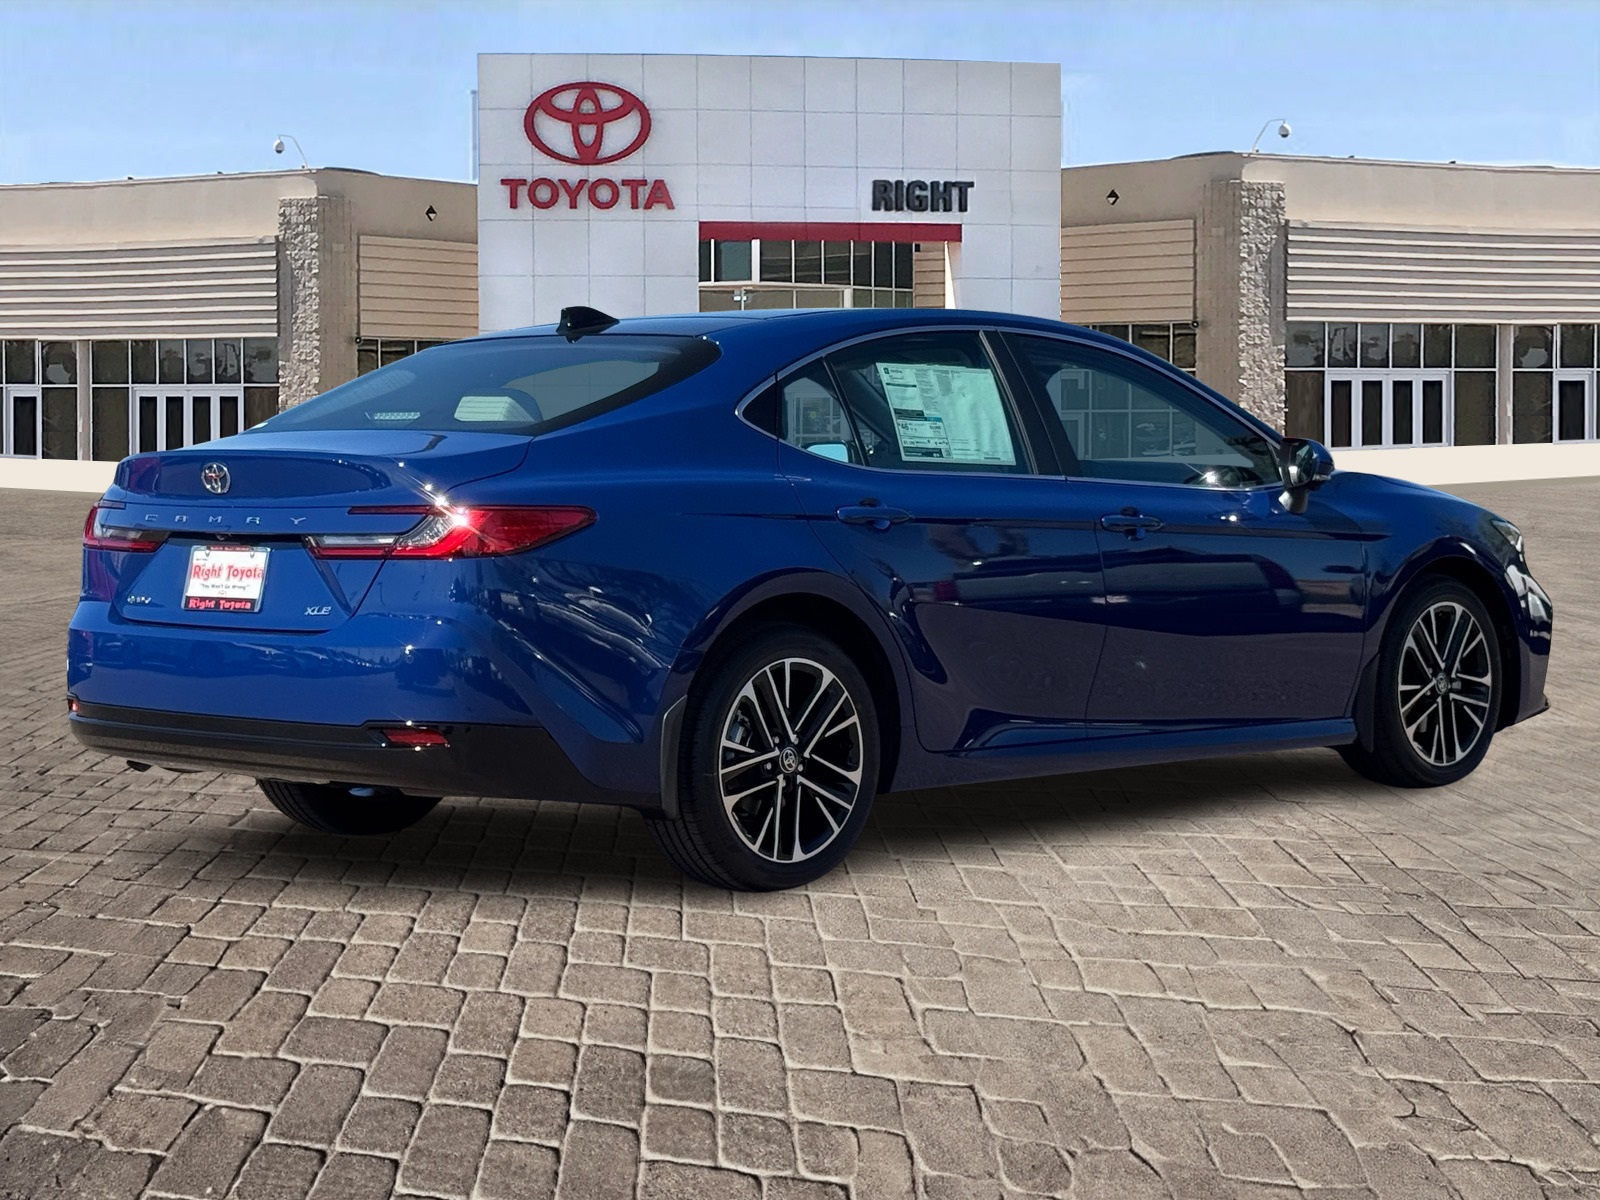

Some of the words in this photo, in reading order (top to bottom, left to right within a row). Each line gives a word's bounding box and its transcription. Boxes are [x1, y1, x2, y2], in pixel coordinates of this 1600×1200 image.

[500, 179, 675, 211] TOYOTA
[872, 180, 975, 213] RIGHT
[144, 513, 307, 526] CAMRY
[192, 564, 222, 581] Right
[227, 565, 264, 580] Toyota
[188, 598, 216, 609] Right
[219, 599, 251, 610] Toyota
[304, 605, 332, 616] XLE
